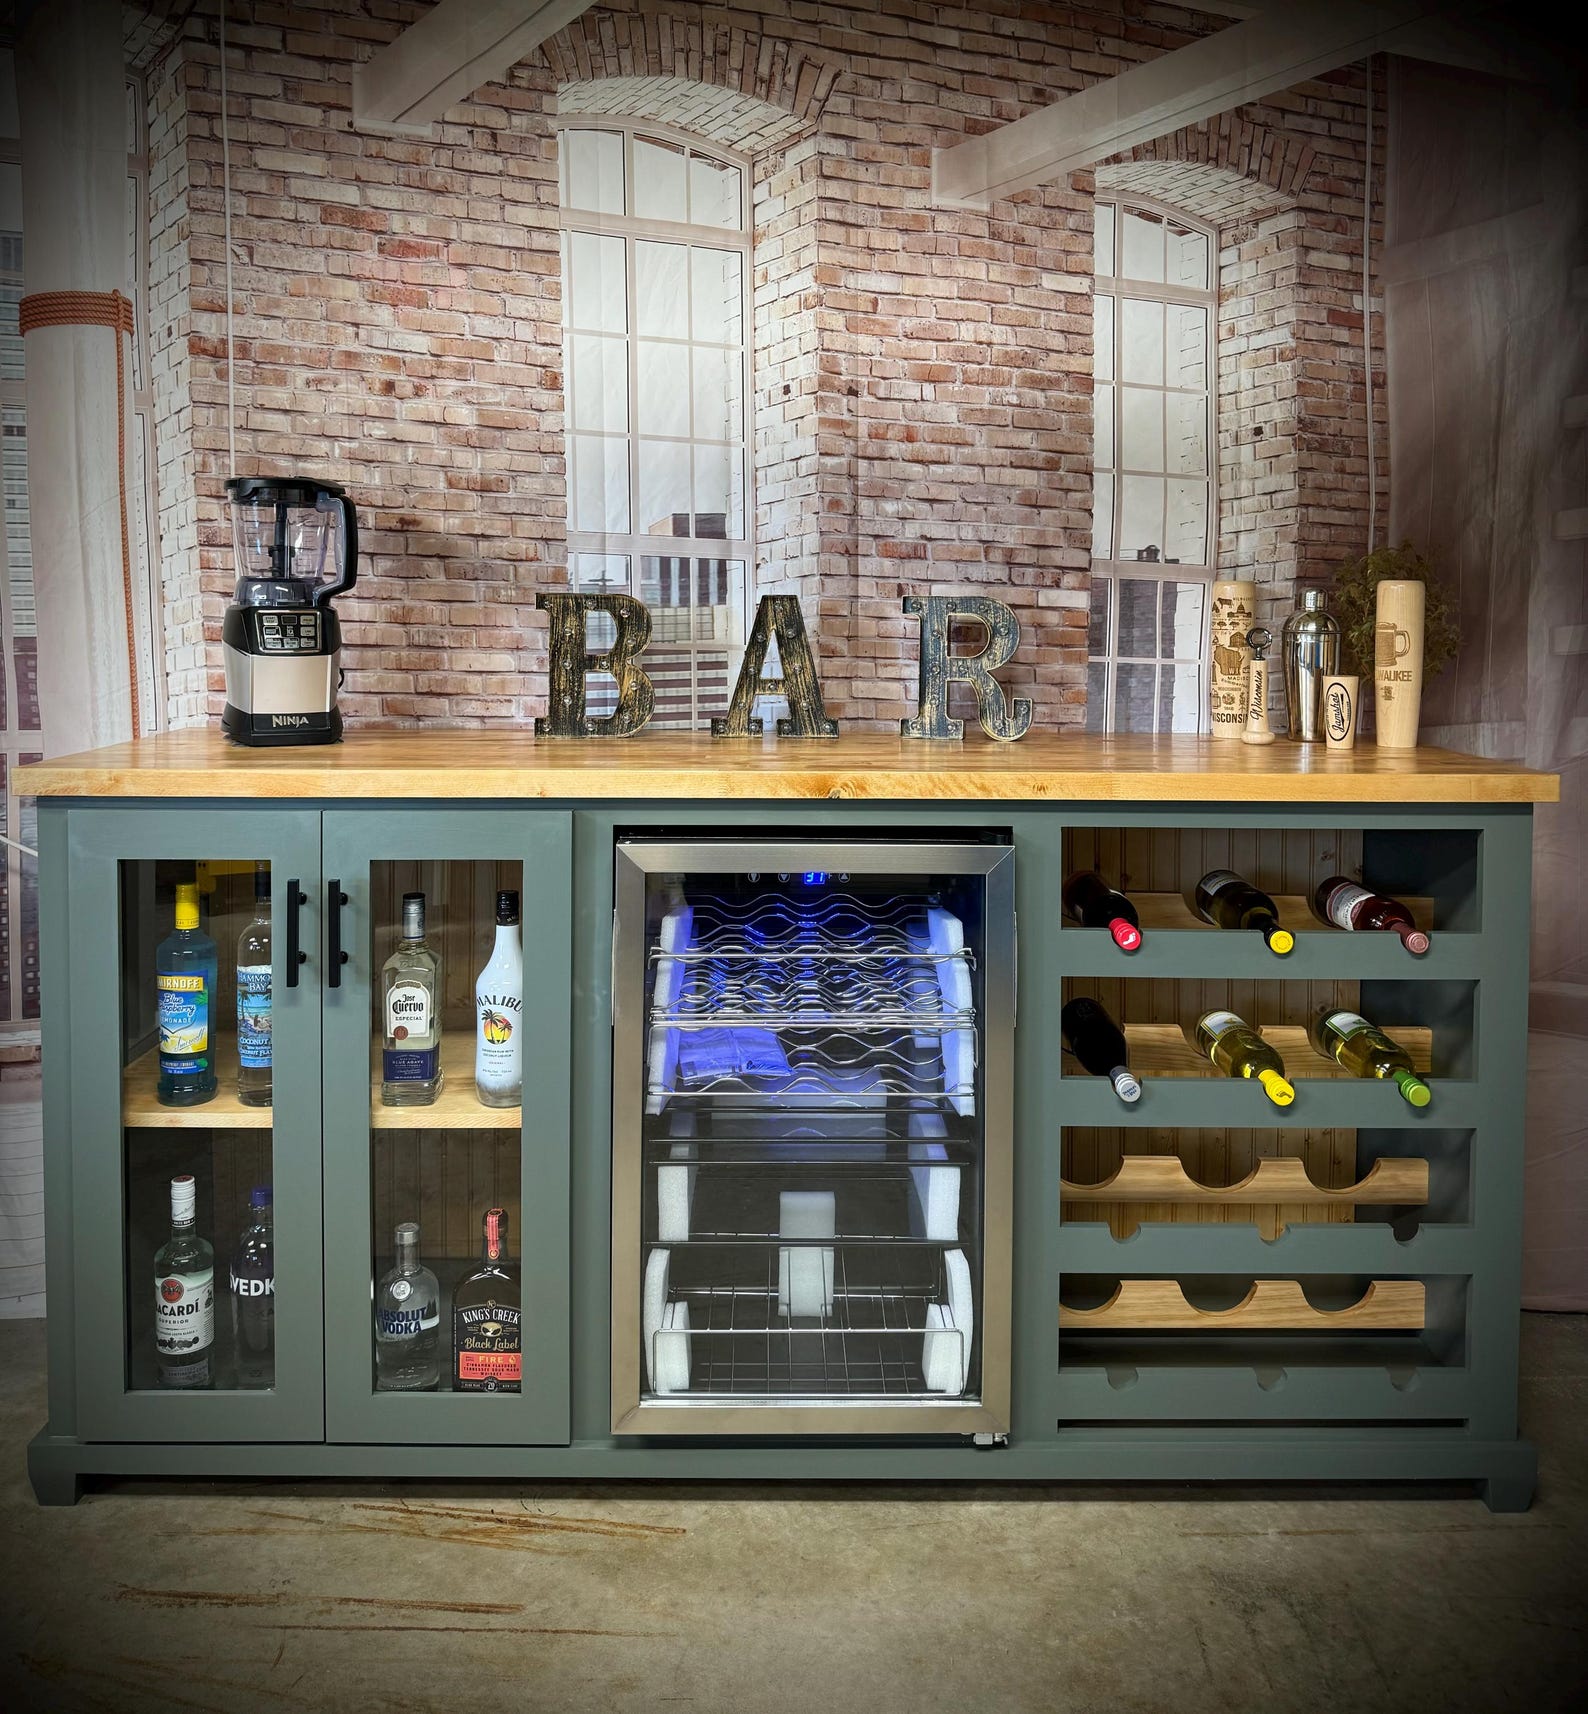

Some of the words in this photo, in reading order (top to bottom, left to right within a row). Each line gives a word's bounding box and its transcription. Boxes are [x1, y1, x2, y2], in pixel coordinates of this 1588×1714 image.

[1249, 670, 1264, 721] Wisconsin
[272, 714, 309, 729] NINJA
[250, 982, 266, 991] BAY
[163, 992, 184, 1004] Blue
[392, 999, 424, 1015] Cuervo
[156, 1298, 200, 1317] ACARDÍ
[377, 1306, 427, 1322] ABSOLUT
[462, 1308, 490, 1324] KING'S
[492, 1309, 521, 1325] CREEK
[382, 1320, 422, 1335] VODKA
[464, 1336, 492, 1350] Black
[492, 1336, 520, 1352] Label
[479, 1355, 505, 1364] FIRE
